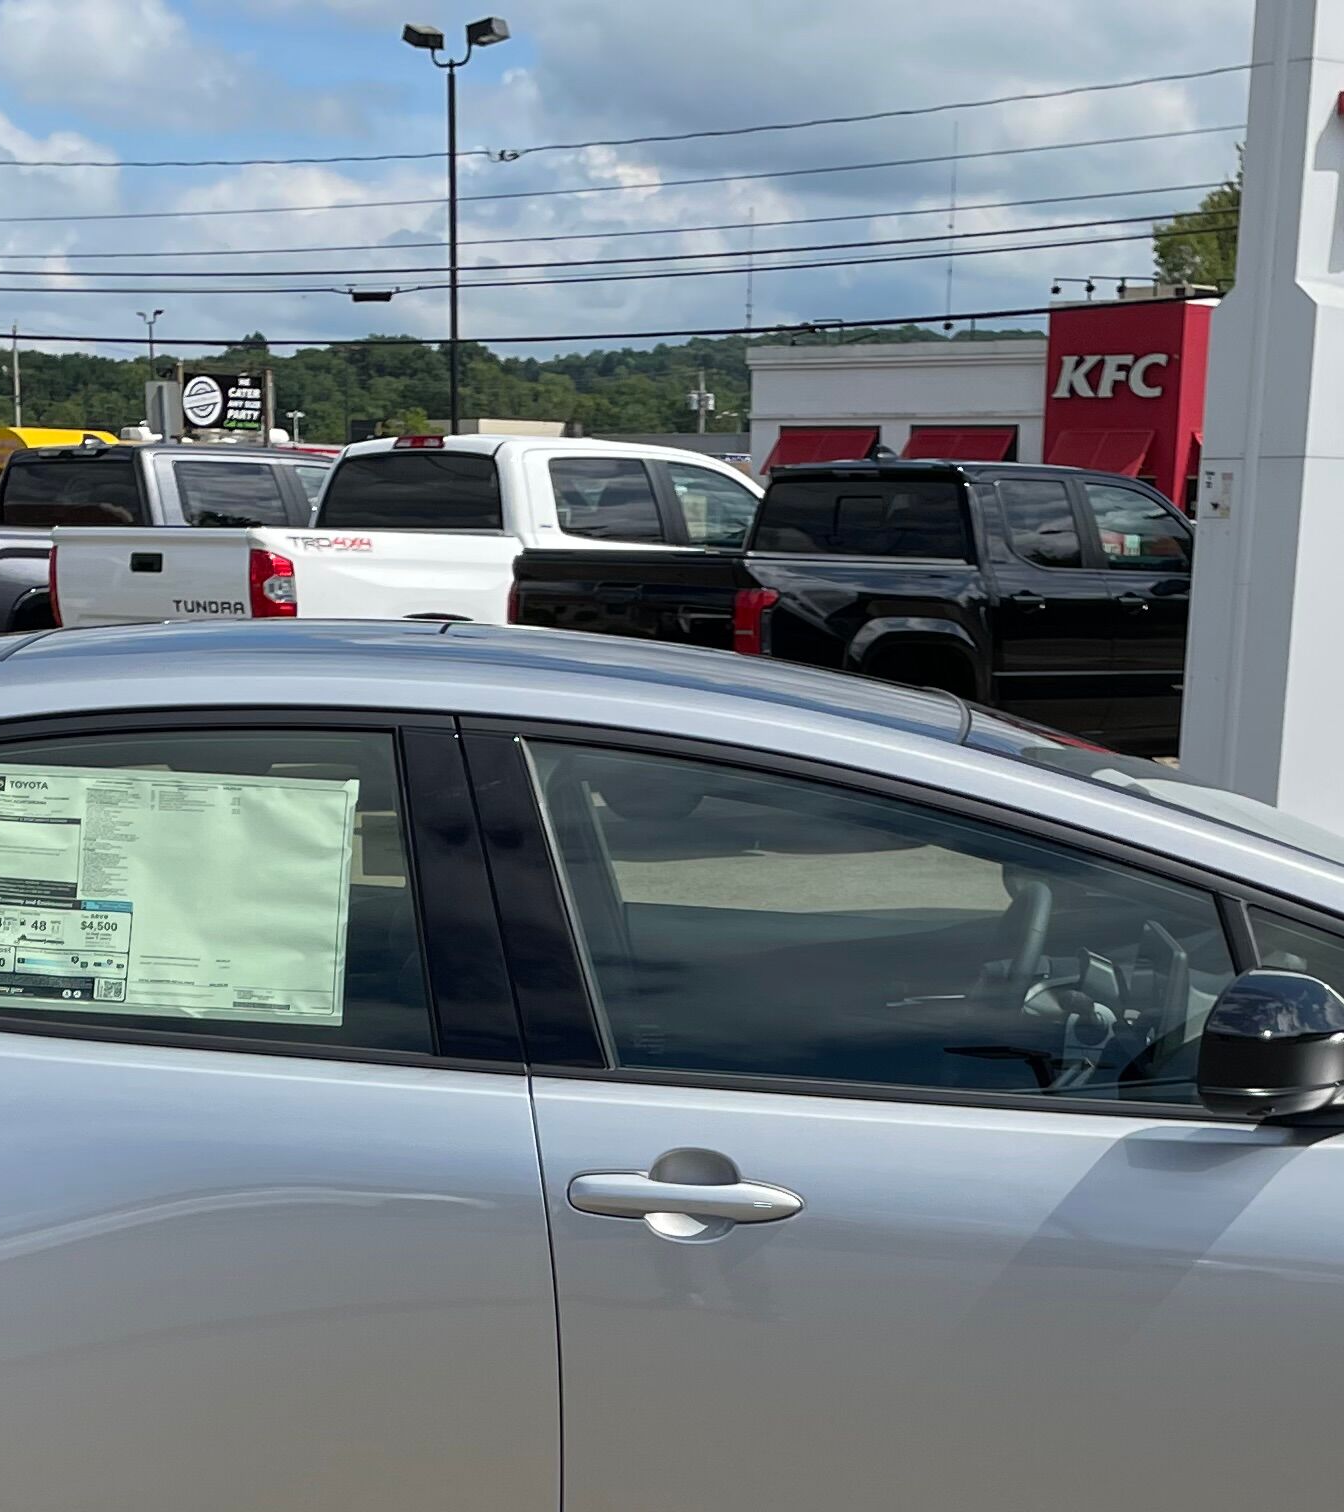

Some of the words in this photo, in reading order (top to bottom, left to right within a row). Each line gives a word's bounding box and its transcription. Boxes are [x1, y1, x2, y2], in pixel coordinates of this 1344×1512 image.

[1051, 352, 1169, 398] KFC
[227, 387, 261, 399] CATER
[227, 408, 261, 420] PARTY
[172, 599, 245, 615] TUNDRA
[9, 780, 49, 790] TOYOTA
[30, 919, 47, 932] 48
[80, 920, 118, 932] $4,500
